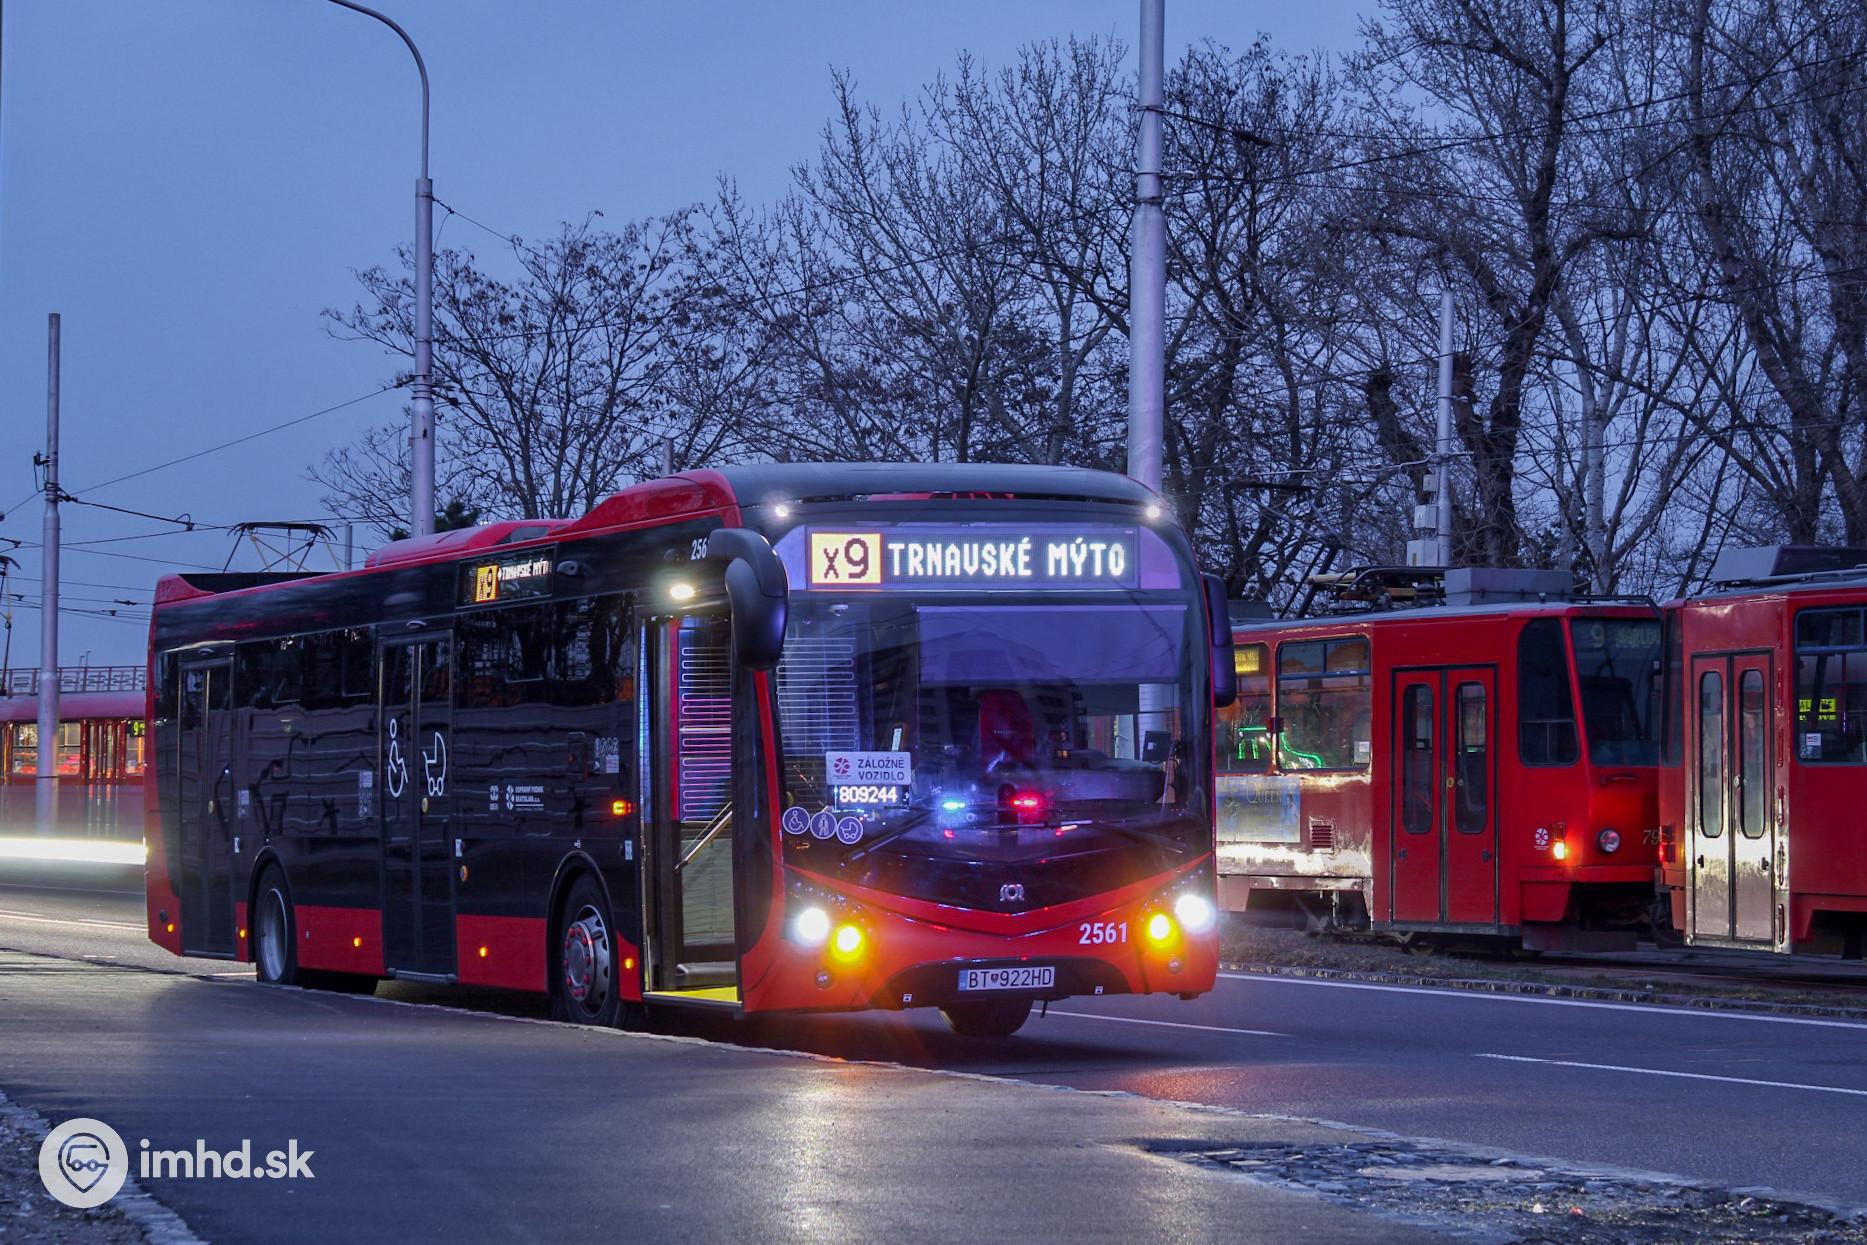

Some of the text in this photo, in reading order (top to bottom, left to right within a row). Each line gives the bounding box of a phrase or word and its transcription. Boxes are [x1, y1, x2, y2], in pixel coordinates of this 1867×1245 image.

[690, 537, 710, 560] 256
[888, 536, 1031, 576] TRNAVSKÉ
[1048, 536, 1125, 577] MÝTO
[857, 756, 905, 769] ZÁLOŽNÉ
[858, 771, 905, 781] VOZIDLO
[839, 786, 898, 803] 809244
[1078, 922, 1128, 944] 2561
